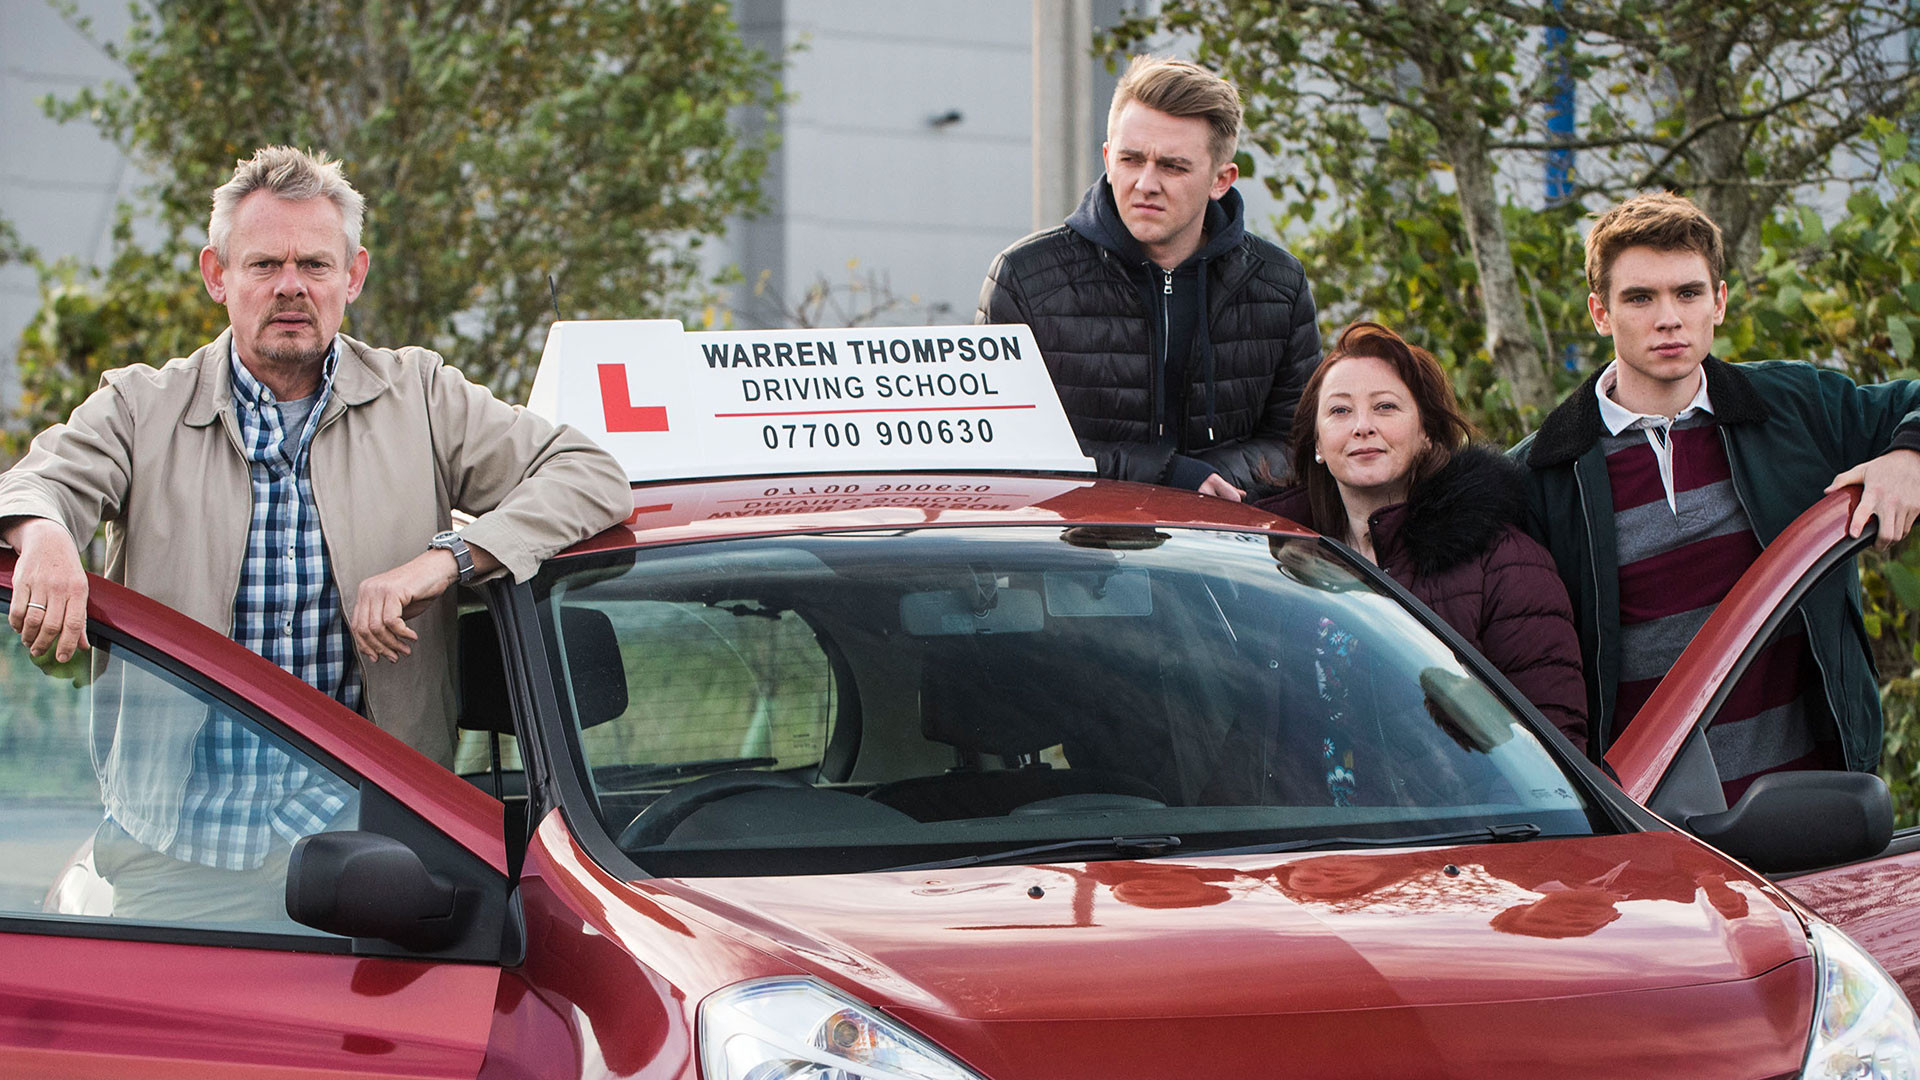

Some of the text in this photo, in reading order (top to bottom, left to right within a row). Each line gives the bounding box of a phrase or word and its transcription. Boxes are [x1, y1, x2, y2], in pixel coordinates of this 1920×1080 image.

[701, 336, 1022, 369] WARREN THOMPSON
[598, 363, 669, 433] L
[741, 373, 999, 402] DRIVING SCHOOL
[762, 419, 994, 450] 07700 900630
